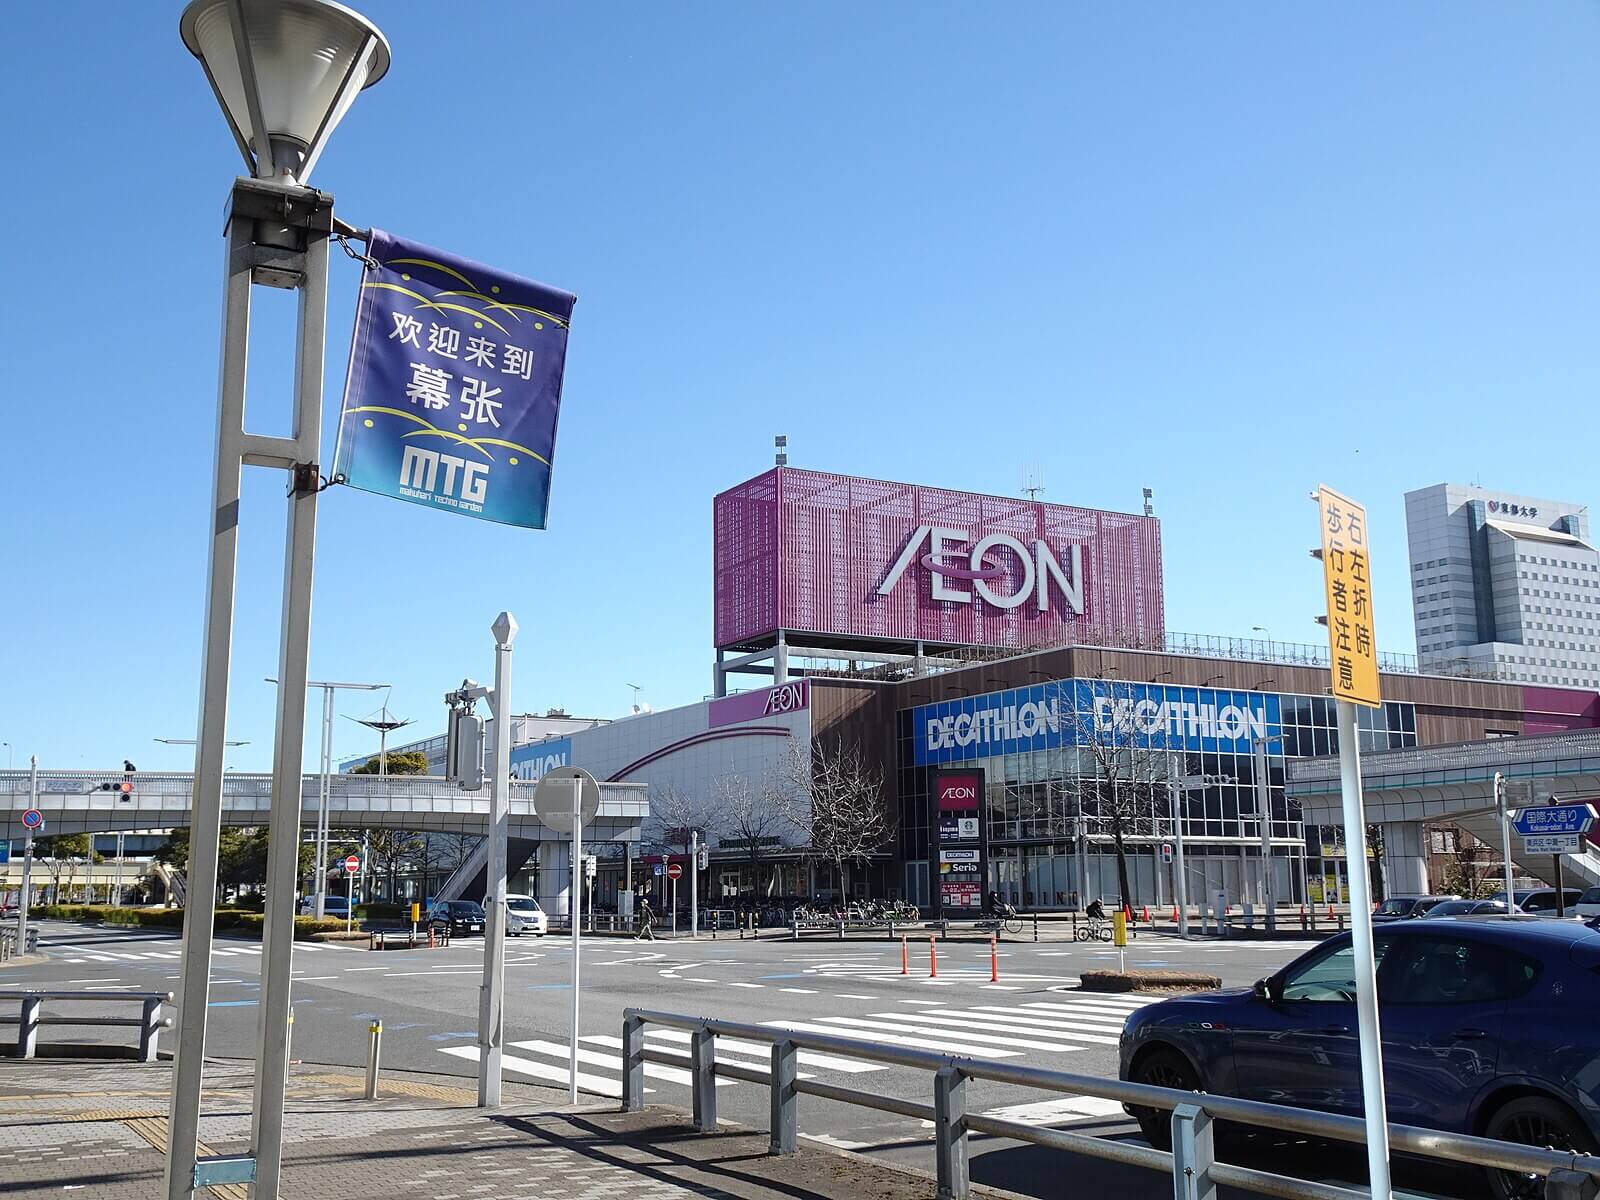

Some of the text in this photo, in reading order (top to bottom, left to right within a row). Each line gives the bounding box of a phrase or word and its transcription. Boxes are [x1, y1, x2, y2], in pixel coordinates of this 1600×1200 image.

[388, 311, 534, 381] 欢迎来到
[406, 362, 503, 429] 幕张
[1326, 502, 1355, 692] 歩行者注意
[1346, 511, 1371, 659] 右左折時
[927, 698, 1060, 751] DECATHLON
[1094, 696, 1265, 740] DECATHLON
[1526, 809, 1577, 824] 国際大通り
[952, 863, 977, 872] Seria
